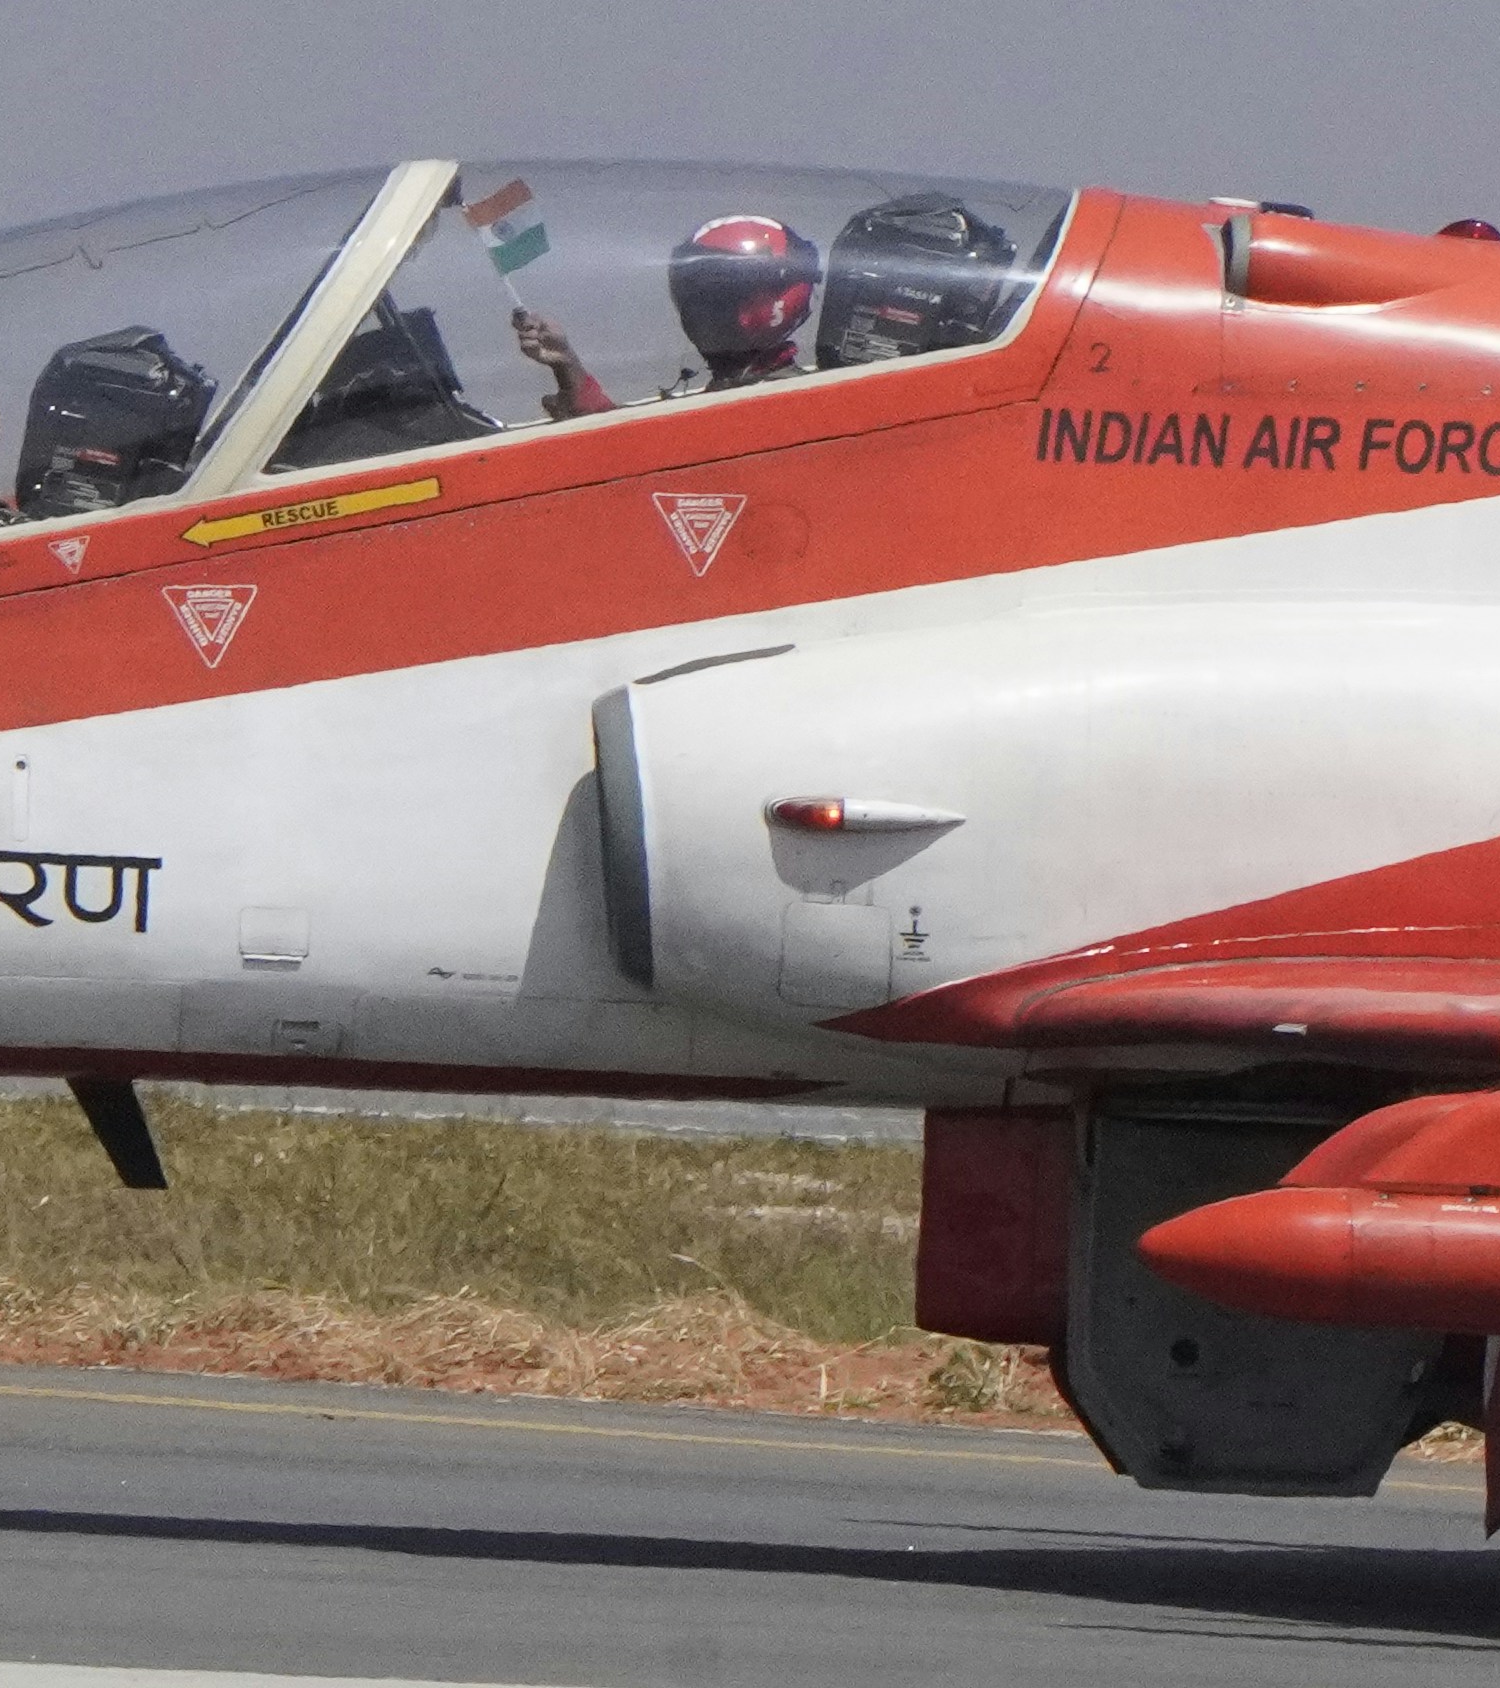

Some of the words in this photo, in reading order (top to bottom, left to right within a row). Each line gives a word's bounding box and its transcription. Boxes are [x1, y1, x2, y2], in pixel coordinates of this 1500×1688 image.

[1090, 342, 1112, 373] 2
[1036, 408, 1231, 469] INDIAN
[1243, 415, 1342, 472] AIR
[261, 500, 340, 528] RESCUE
